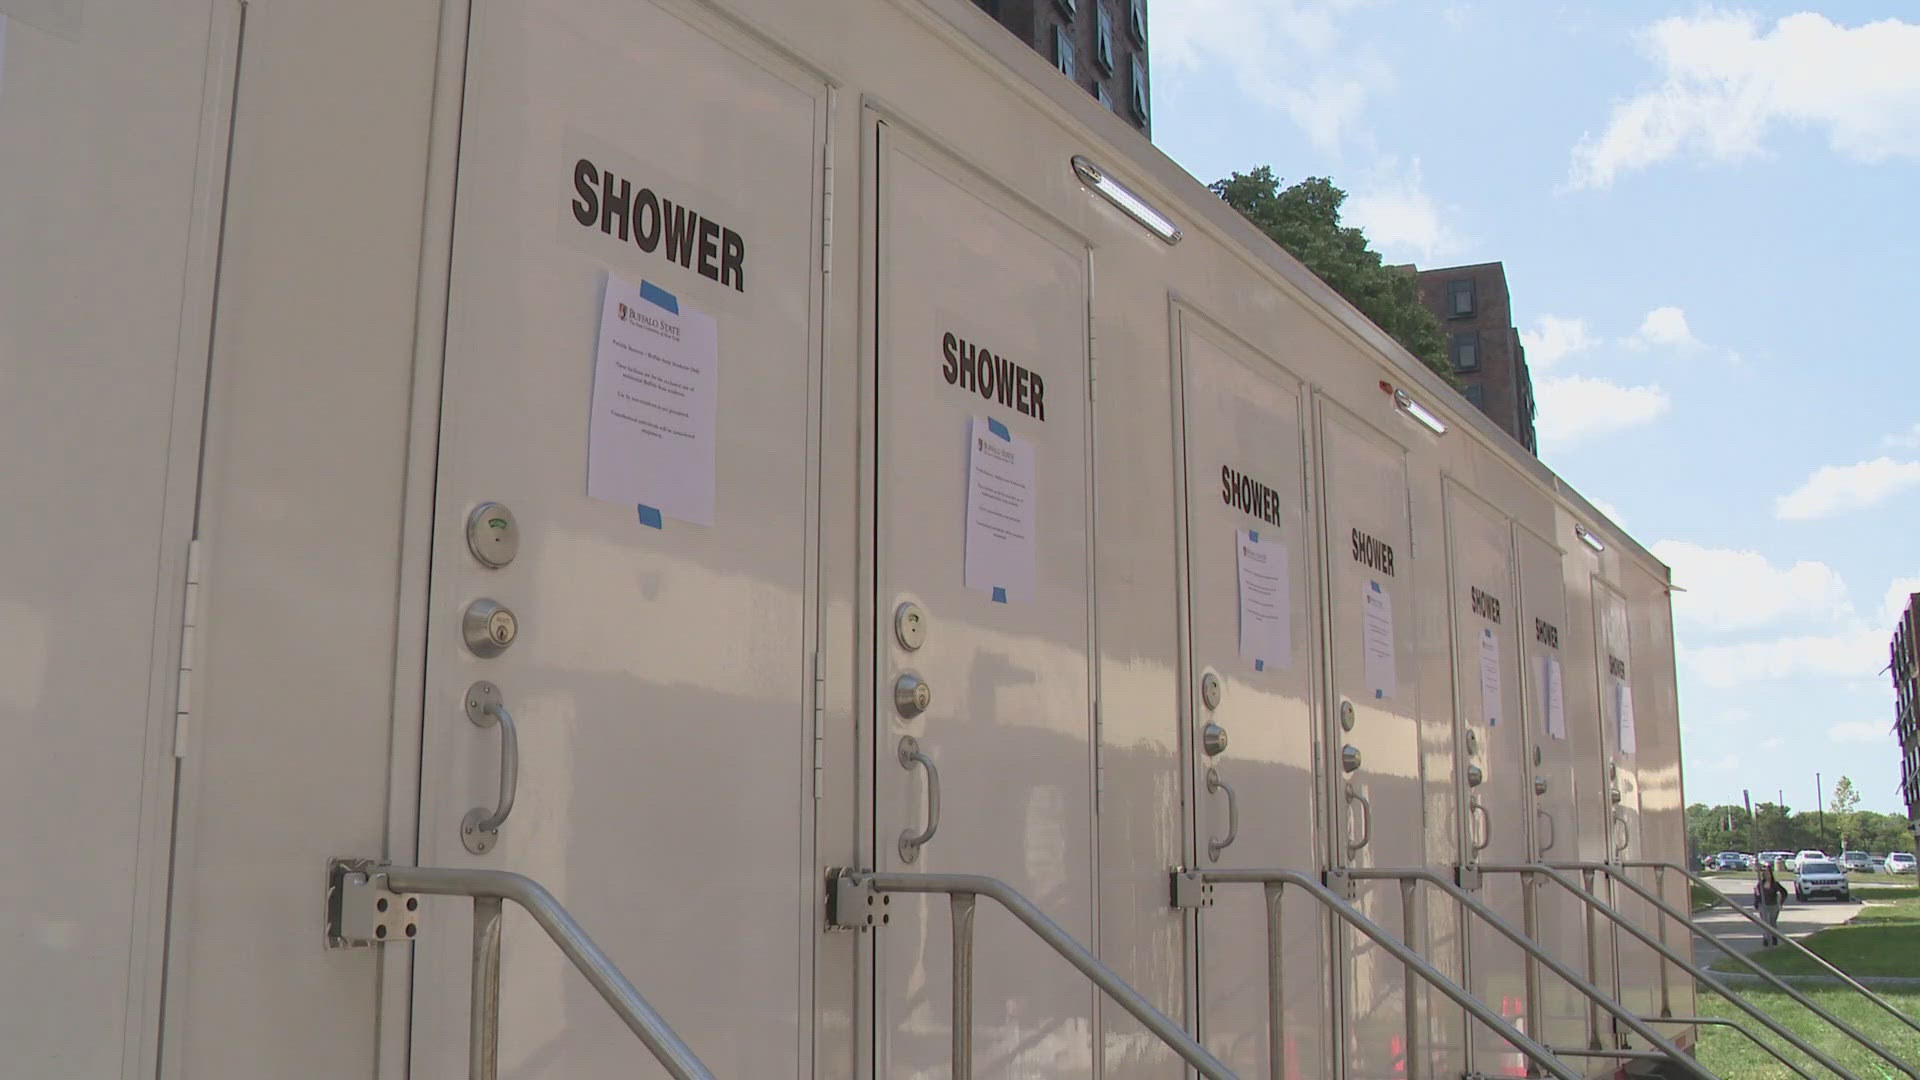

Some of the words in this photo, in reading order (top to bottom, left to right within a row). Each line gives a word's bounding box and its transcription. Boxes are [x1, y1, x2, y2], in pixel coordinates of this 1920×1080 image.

[572, 159, 744, 292] SHOWER
[629, 308, 659, 327] BUFFALO
[660, 321, 680, 336] STATE
[943, 332, 1044, 422] SHOWER
[1222, 465, 1280, 527] SHOWER
[1352, 528, 1394, 577] SHOWER
[1471, 586, 1500, 624] SHOWER
[1536, 617, 1558, 650] SHOWER
